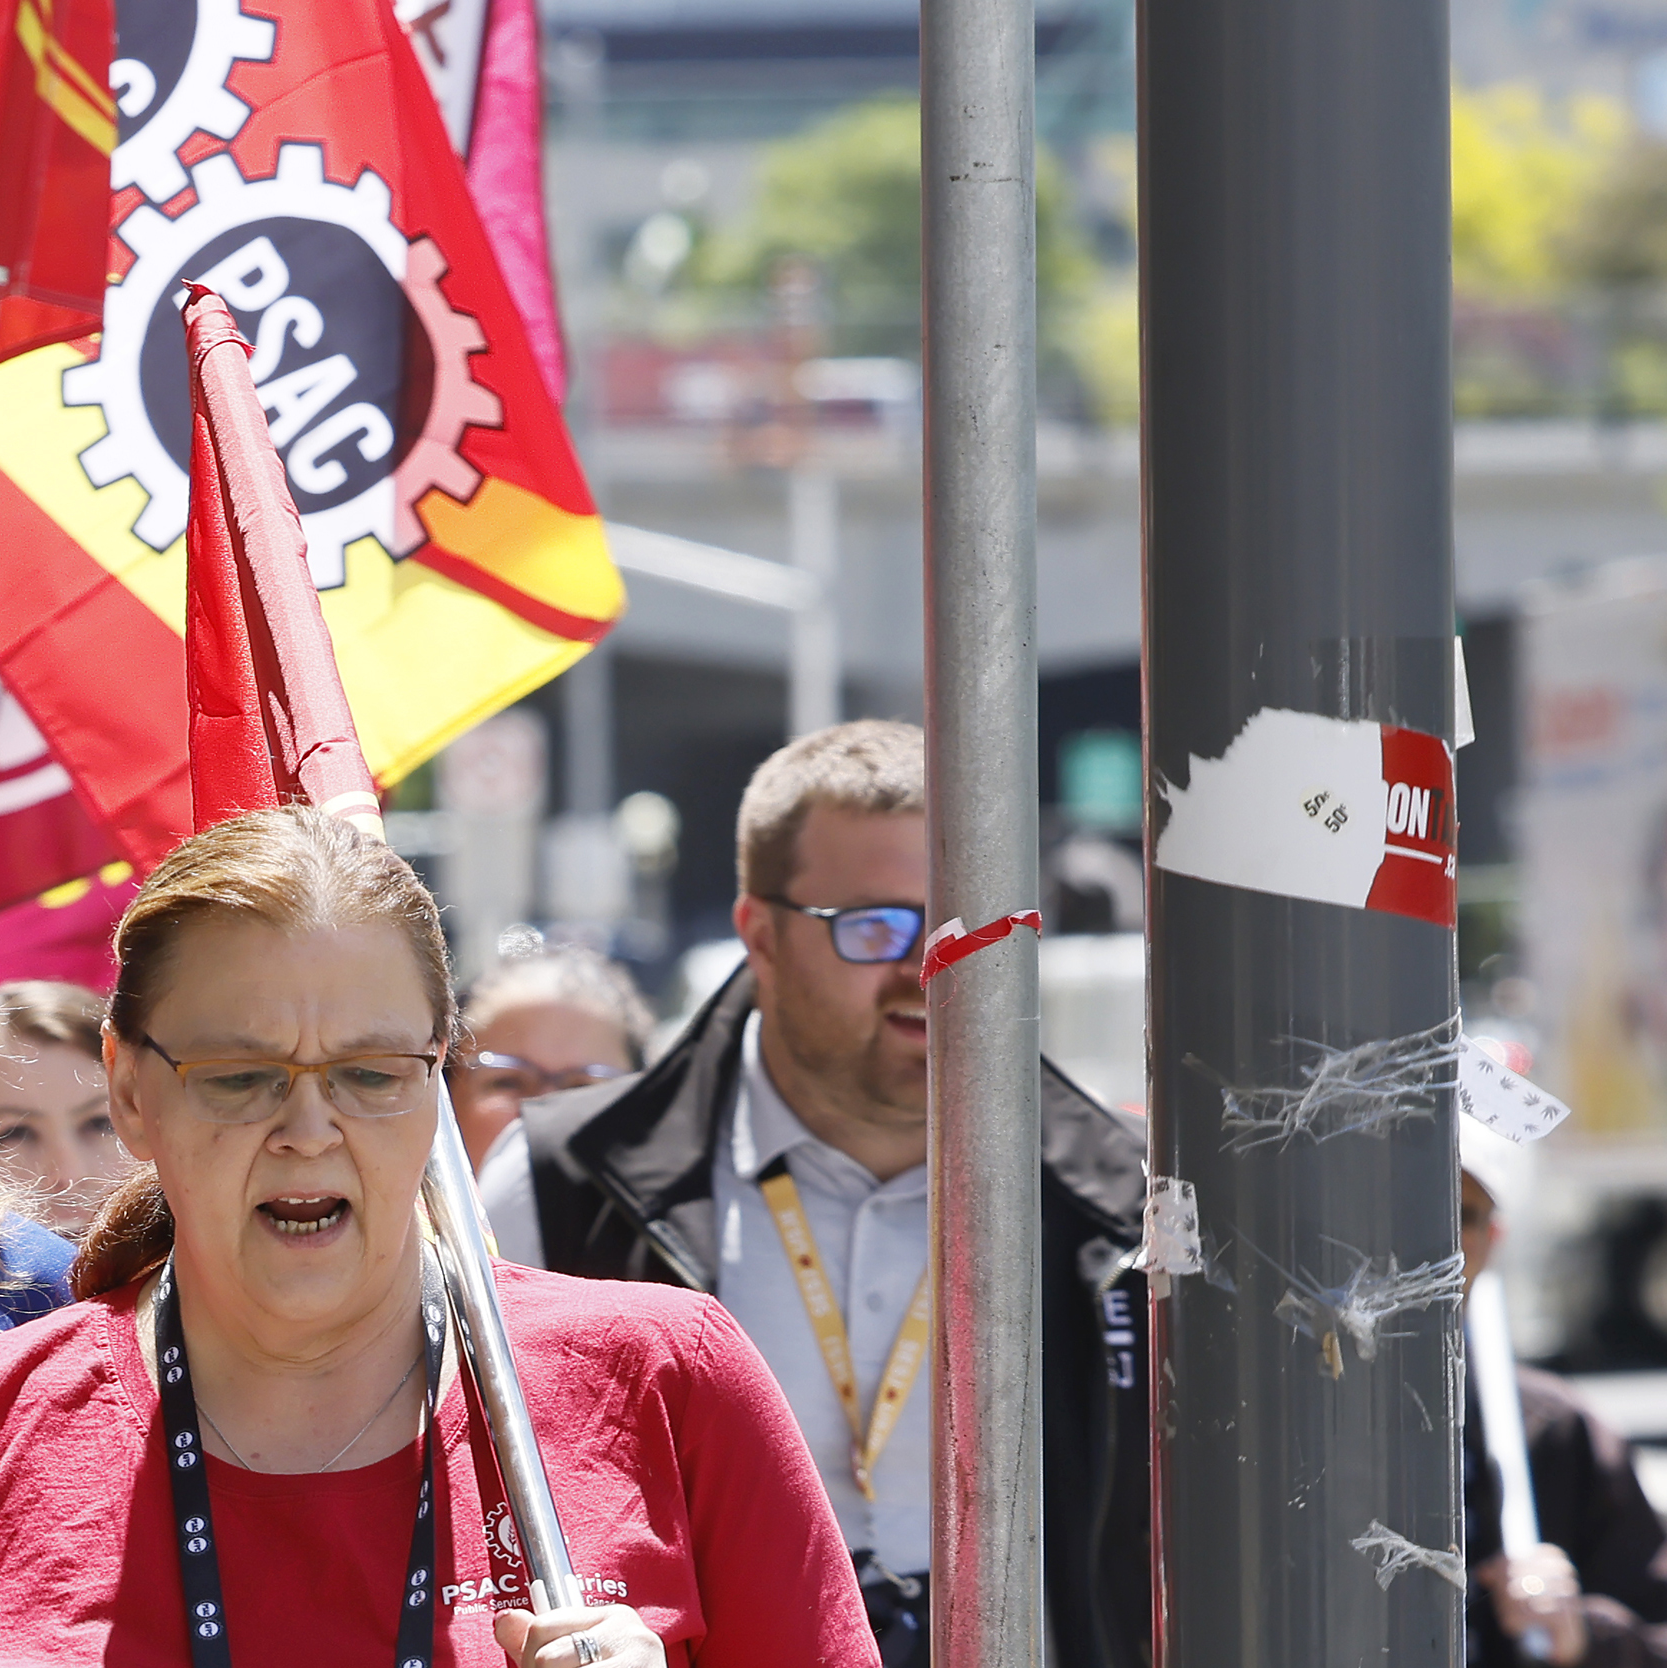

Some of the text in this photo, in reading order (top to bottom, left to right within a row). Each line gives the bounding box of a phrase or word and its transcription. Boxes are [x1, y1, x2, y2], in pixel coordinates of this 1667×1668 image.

[172, 235, 395, 495] PSAC
[441, 1573, 520, 1605] PSAC
[453, 1602, 488, 1615] Public
[490, 1596, 529, 1611] Service
